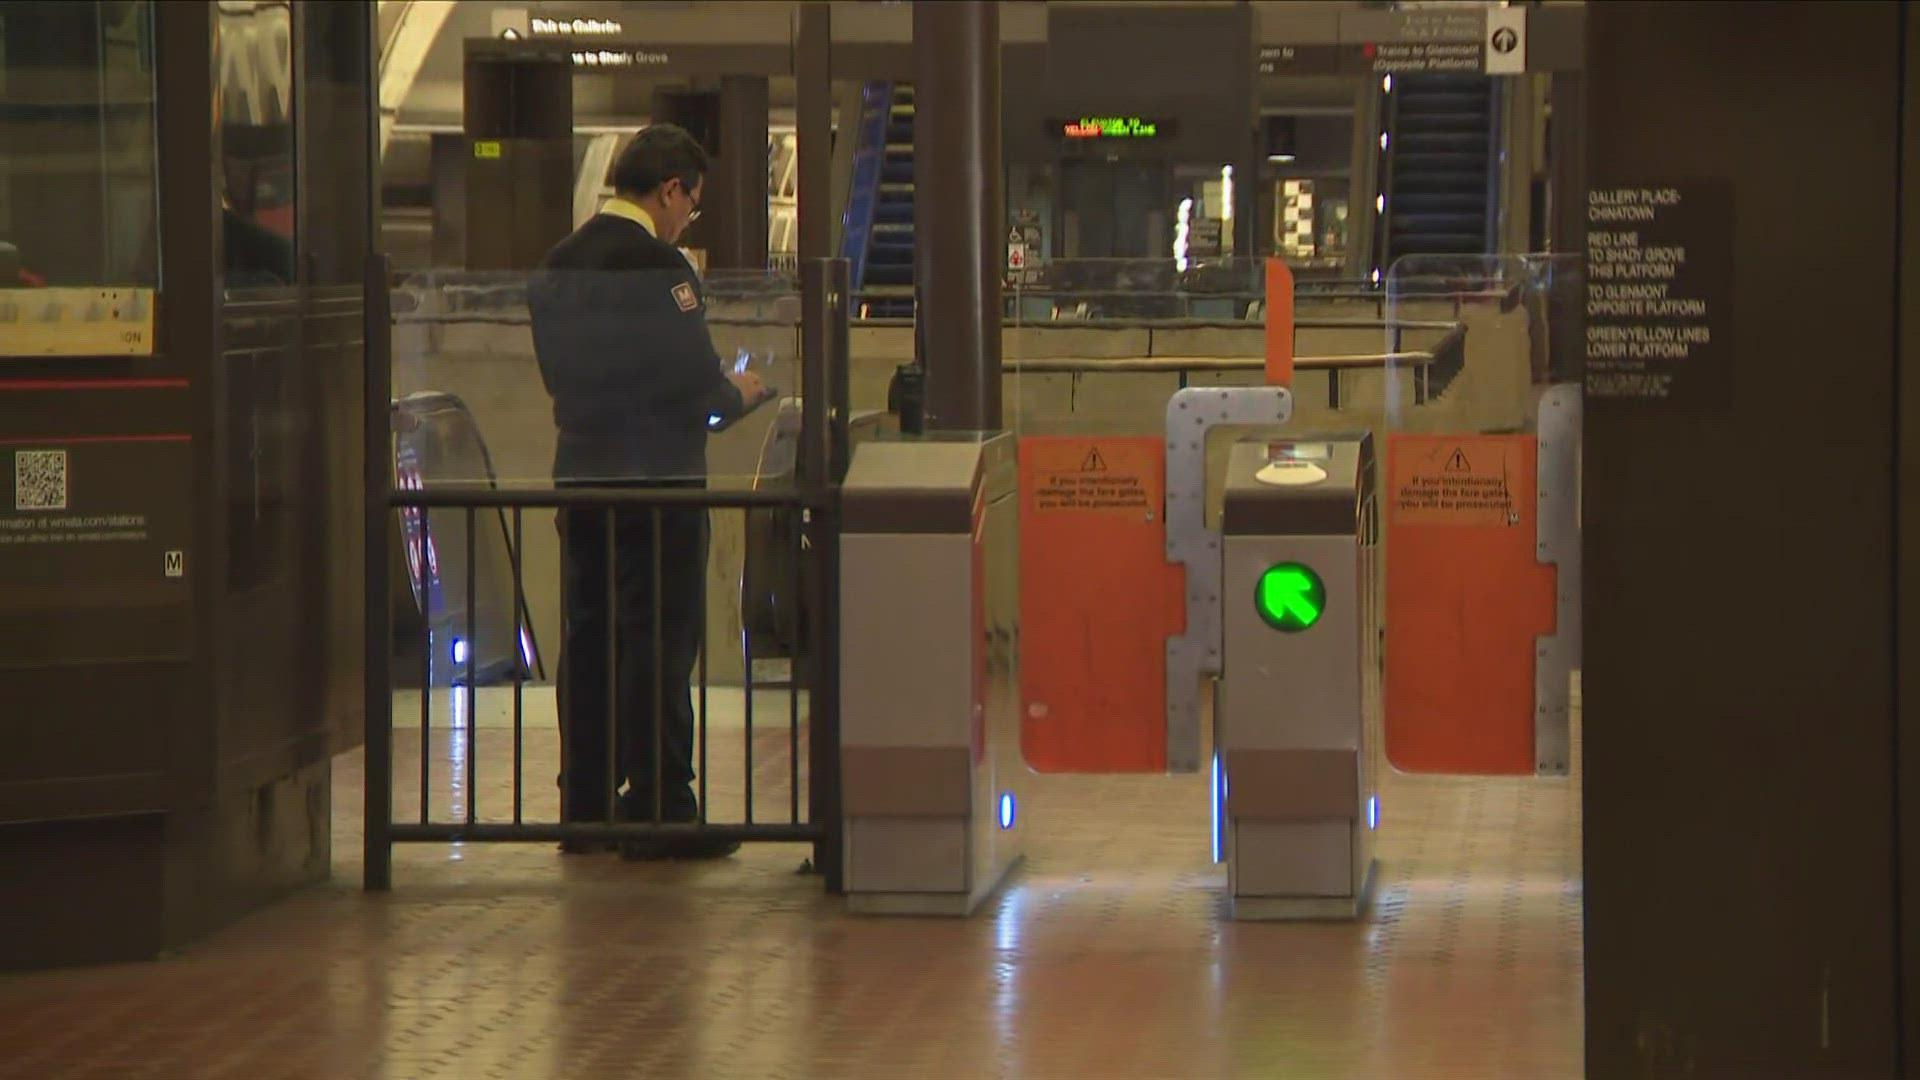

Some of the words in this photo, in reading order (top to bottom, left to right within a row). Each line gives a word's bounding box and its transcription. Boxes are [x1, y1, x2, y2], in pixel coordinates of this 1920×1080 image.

[1282, 47, 1294, 58] to
[1377, 45, 1410, 56] Trains
[1412, 45, 1423, 56] to
[1426, 44, 1479, 56] Glenmont
[585, 51, 598, 65] to
[599, 51, 632, 66] Shady
[635, 51, 668, 64] Grove
[1588, 189, 1638, 204] GALLERY
[1641, 188, 1681, 204] PLACE-
[1588, 205, 1655, 220] CHINATOWN
[1587, 231, 1611, 247] RED
[1613, 231, 1639, 247] LINE
[1588, 247, 1604, 262] TO
[1605, 247, 1642, 262] SHADY
[1645, 246, 1685, 262] GROVE
[1588, 263, 1614, 278] THIS
[1616, 262, 1675, 278] PLATFORM
[1588, 283, 1604, 299] TO
[1606, 283, 1667, 299] GLENMONT
[1587, 300, 1643, 314] OPPOSITE
[1646, 299, 1706, 314] PLATFORM
[1677, 326, 1710, 343] LINES
[1586, 341, 1627, 357] LOWER
[1629, 341, 1688, 357] PLATFORM
